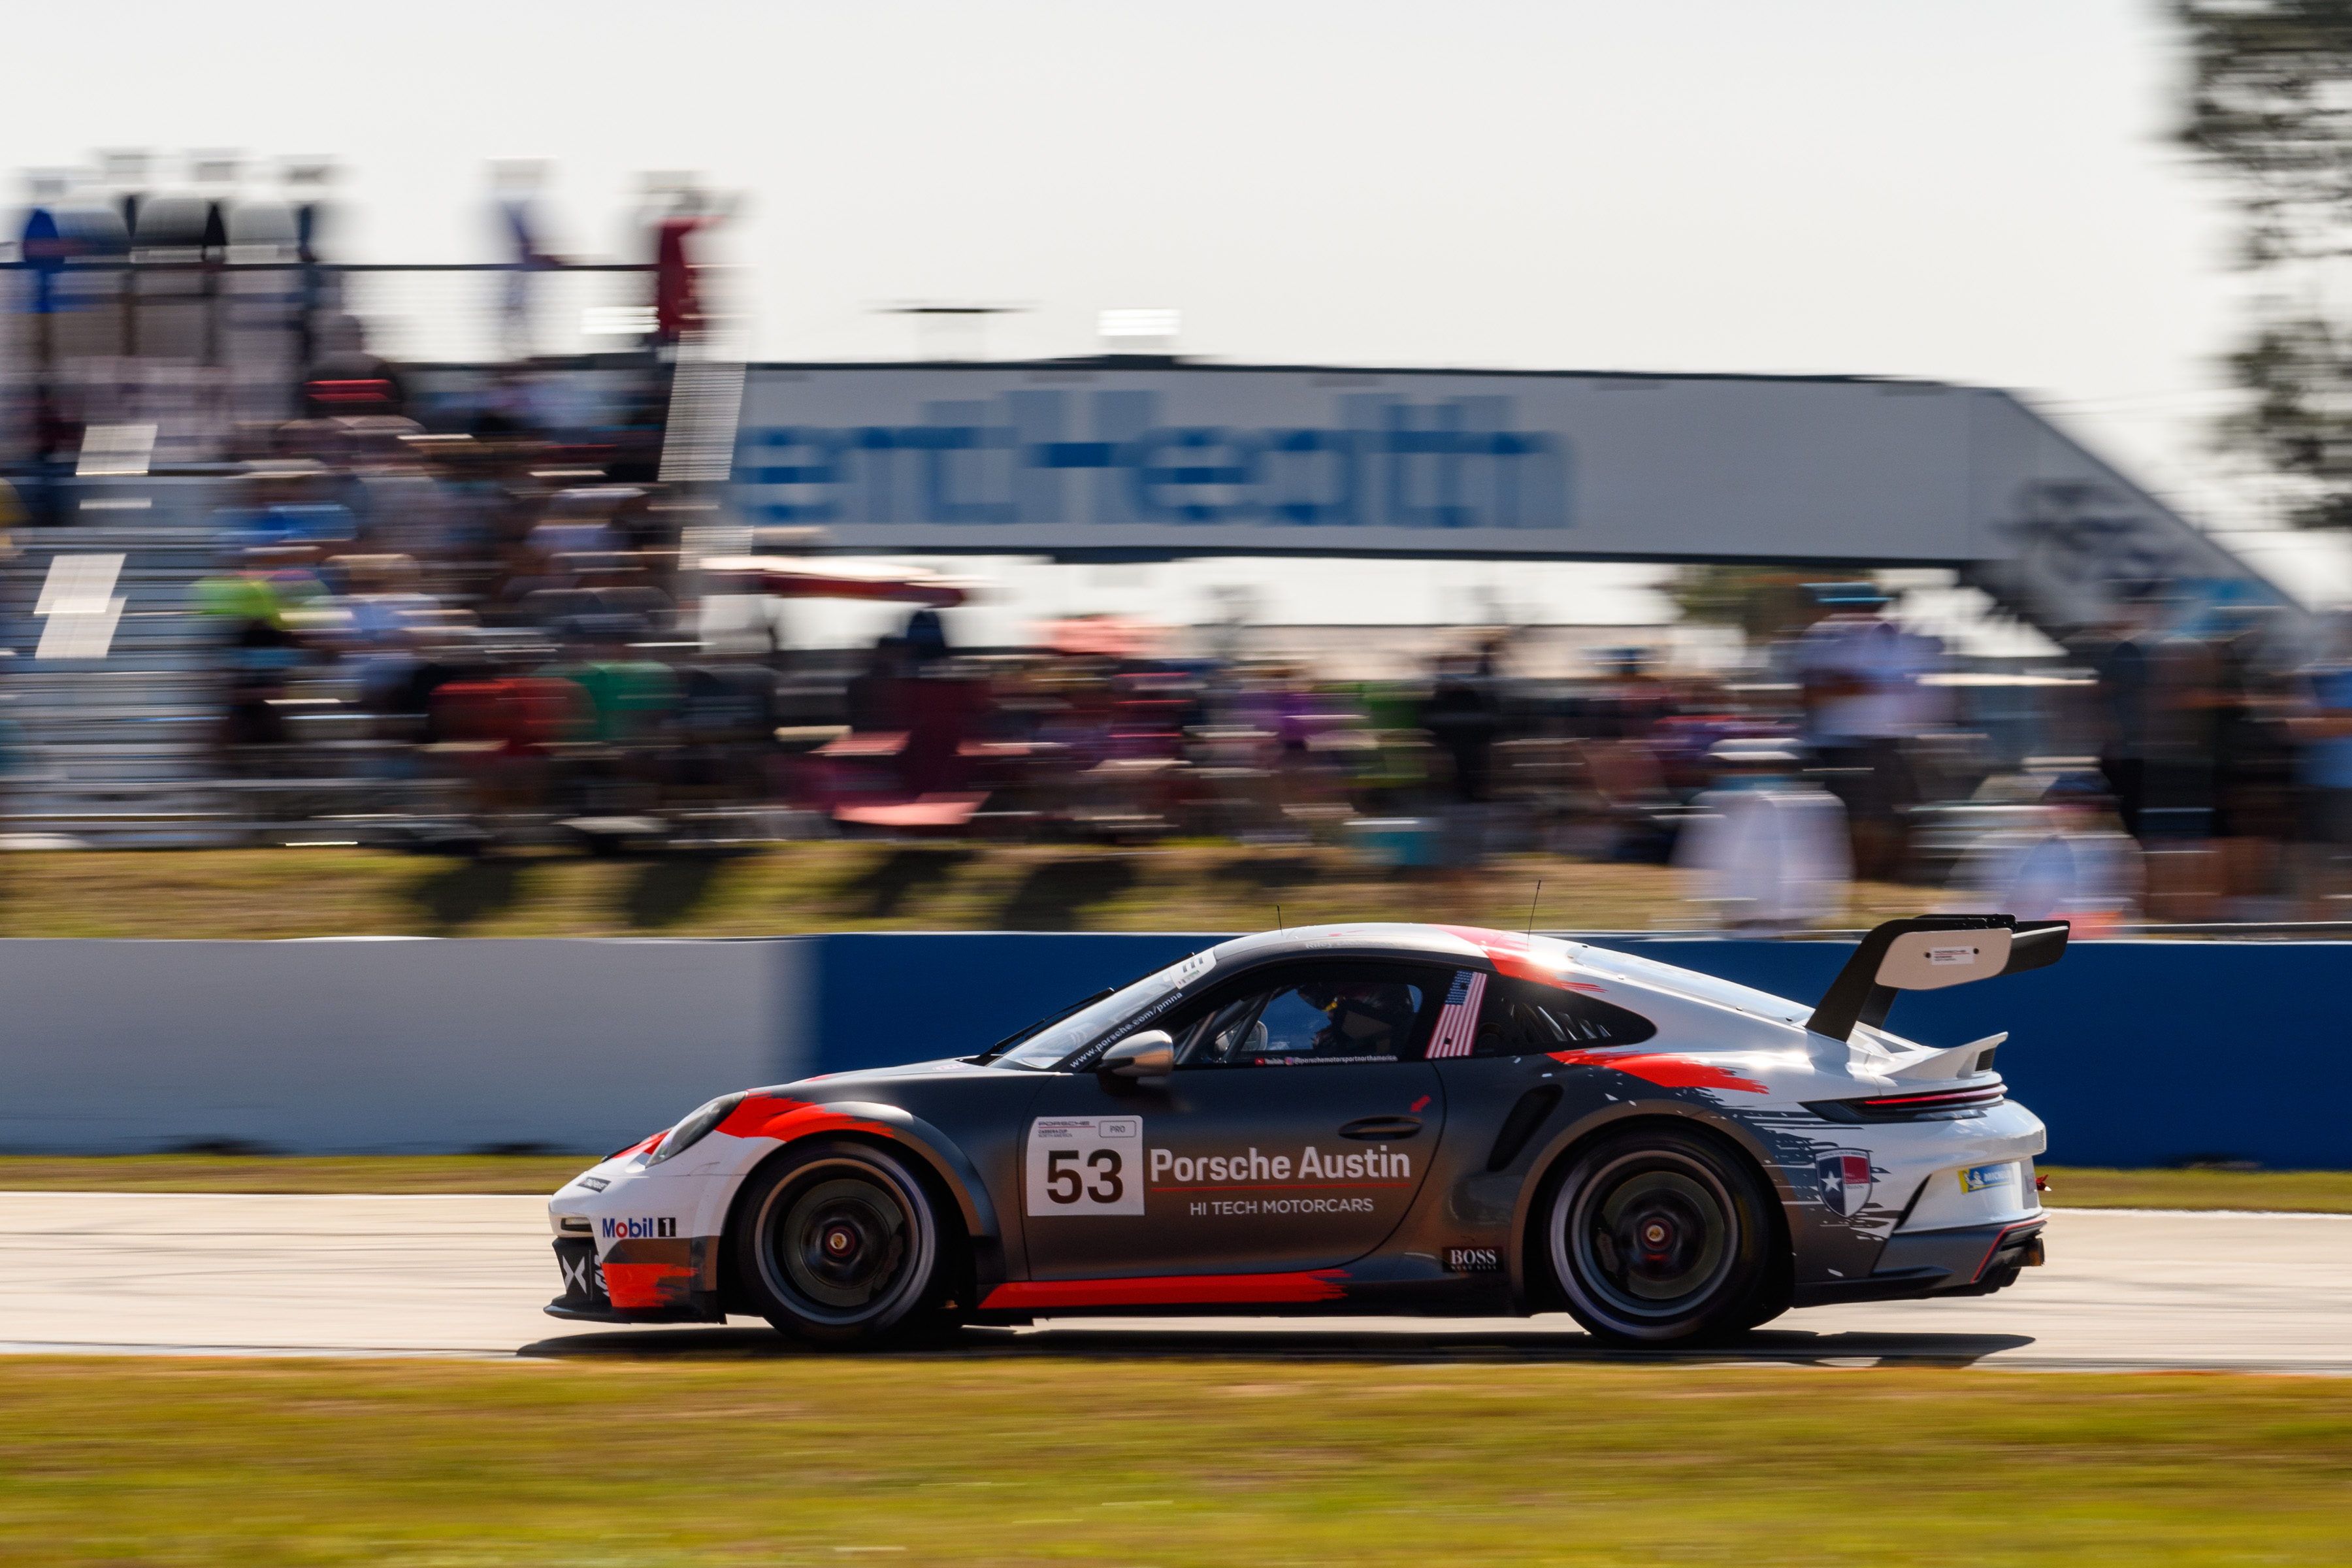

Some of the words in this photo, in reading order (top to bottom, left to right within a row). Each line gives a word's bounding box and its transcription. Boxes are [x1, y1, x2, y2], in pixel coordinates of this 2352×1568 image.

[1070, 992, 1183, 1068] www.porsche.com/pmna
[1109, 1125, 1126, 1134] PRO
[1150, 1147, 1290, 1183] Porsche
[1298, 1145, 1411, 1179] Austin
[1047, 1149, 1124, 1204] 53
[1190, 1202, 1207, 1215] HI
[1211, 1200, 1257, 1215] TECH
[1262, 1198, 1373, 1214] MOTORCARS
[602, 1217, 653, 1238] Mobil
[1450, 1249, 1496, 1264] BOSS
